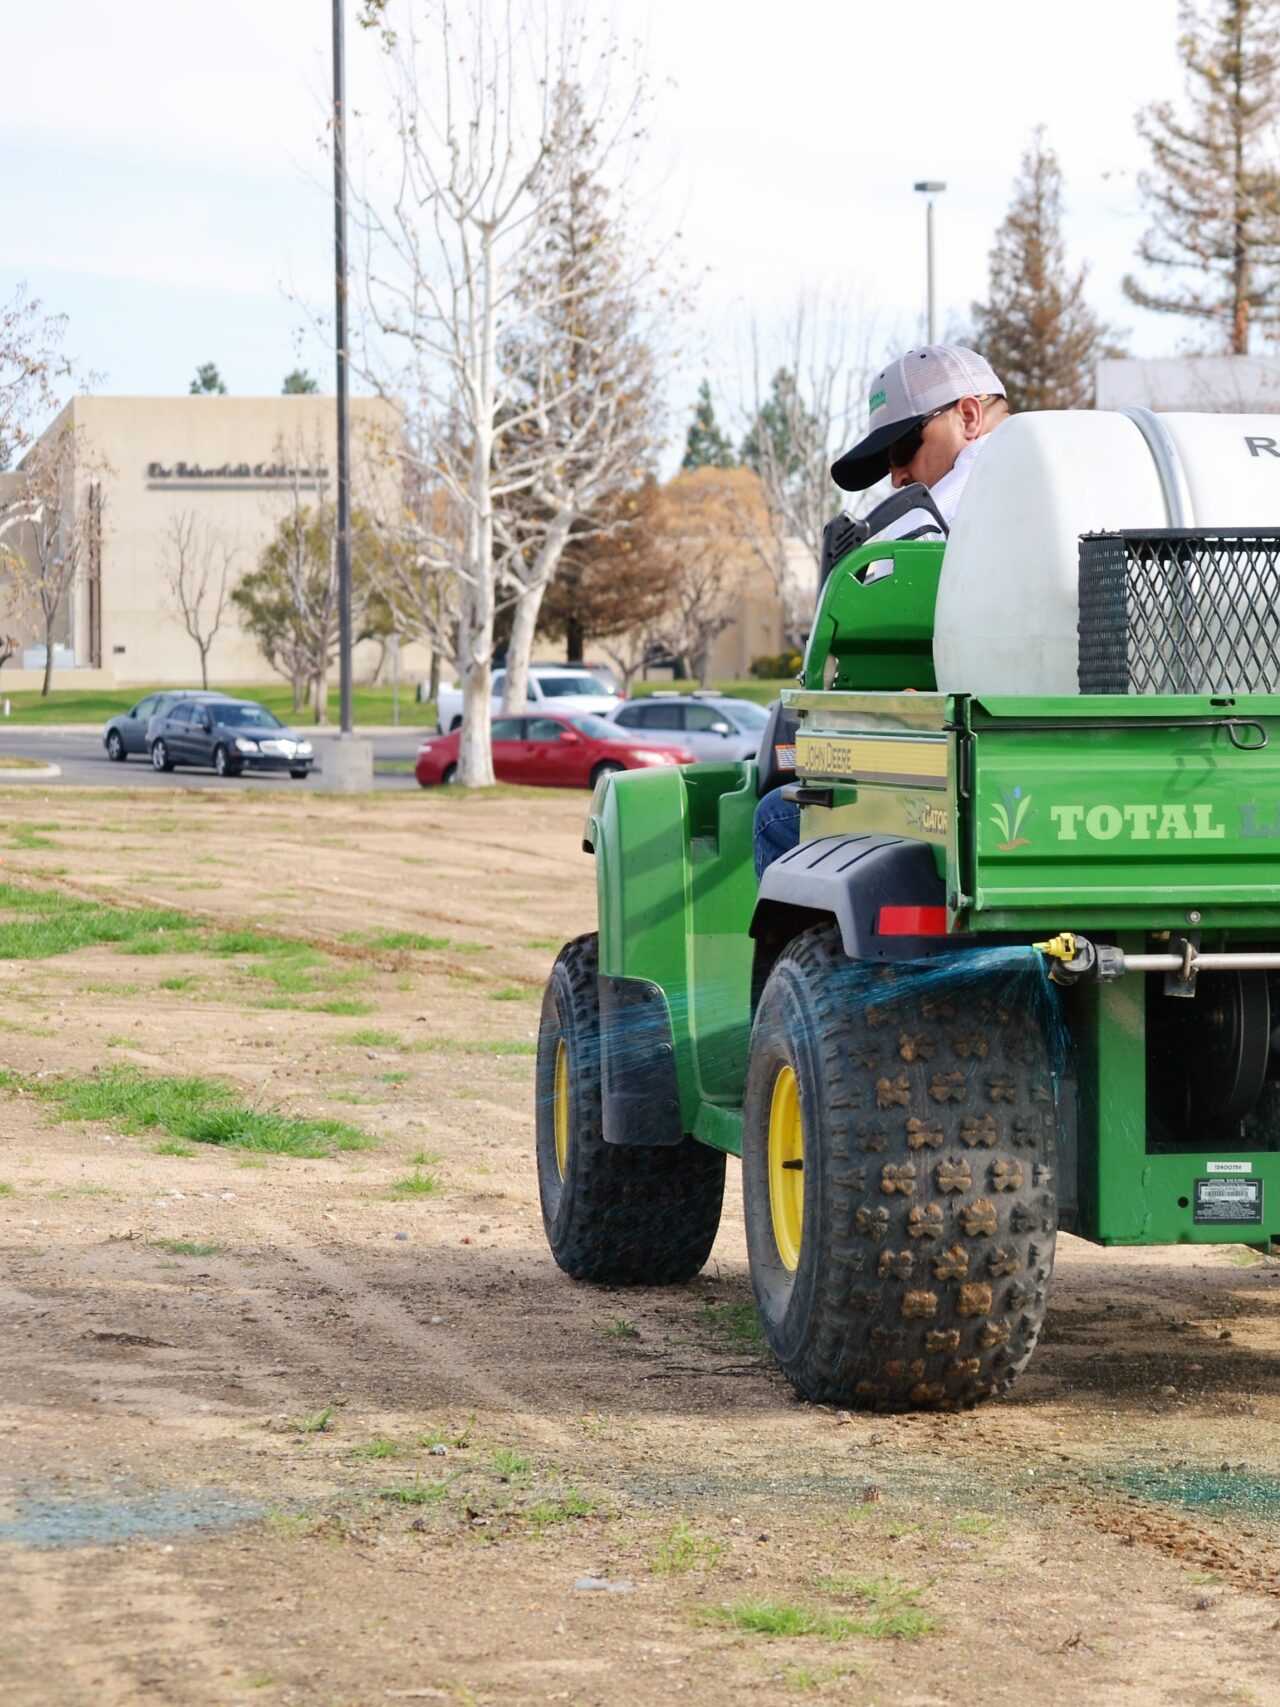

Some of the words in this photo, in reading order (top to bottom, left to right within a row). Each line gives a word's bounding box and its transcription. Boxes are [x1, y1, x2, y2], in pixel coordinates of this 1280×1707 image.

[805, 742, 826, 770] JOHN
[827, 742, 852, 772] DEERE
[1050, 804, 1226, 840] TOTAL
